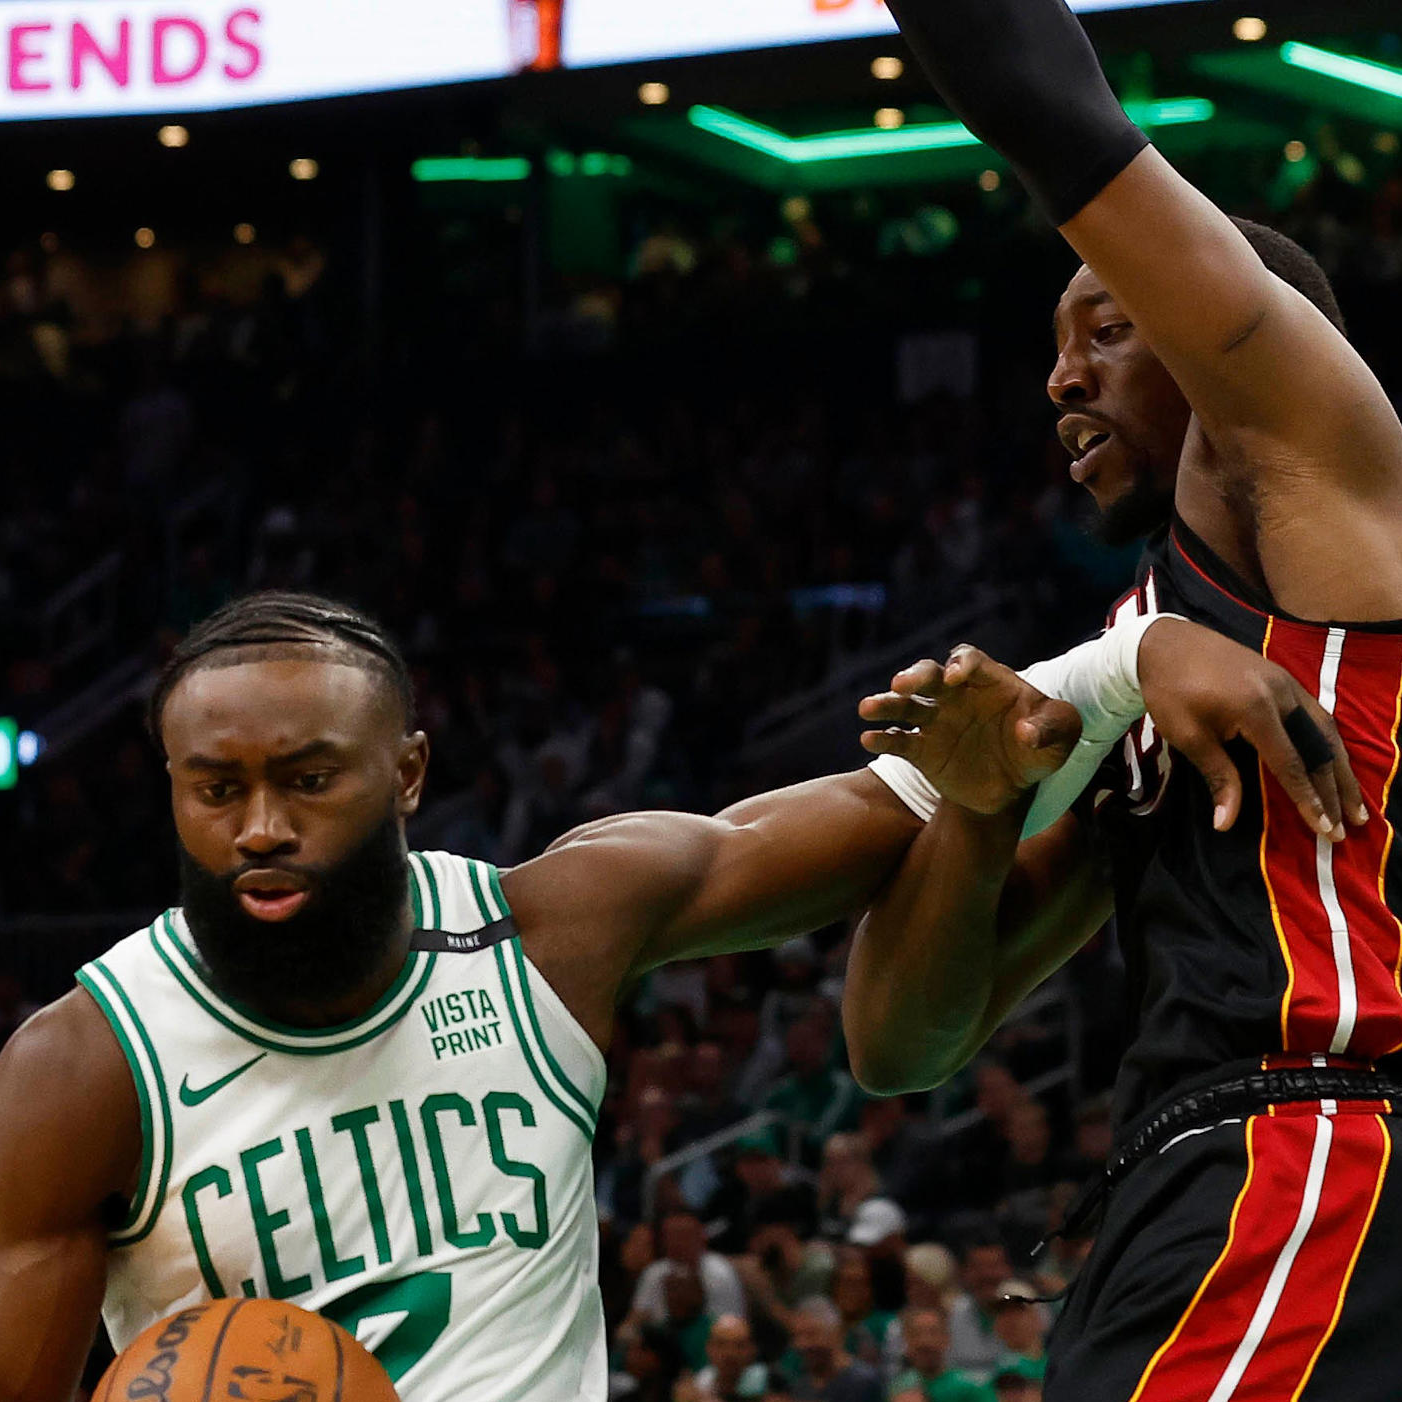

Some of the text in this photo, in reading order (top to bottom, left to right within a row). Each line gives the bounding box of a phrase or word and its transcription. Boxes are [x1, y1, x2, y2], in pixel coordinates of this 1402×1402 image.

[421, 989, 498, 1033] VISTA
[431, 1021, 502, 1060] PRINT
[181, 1091, 550, 1299] CELTICS
